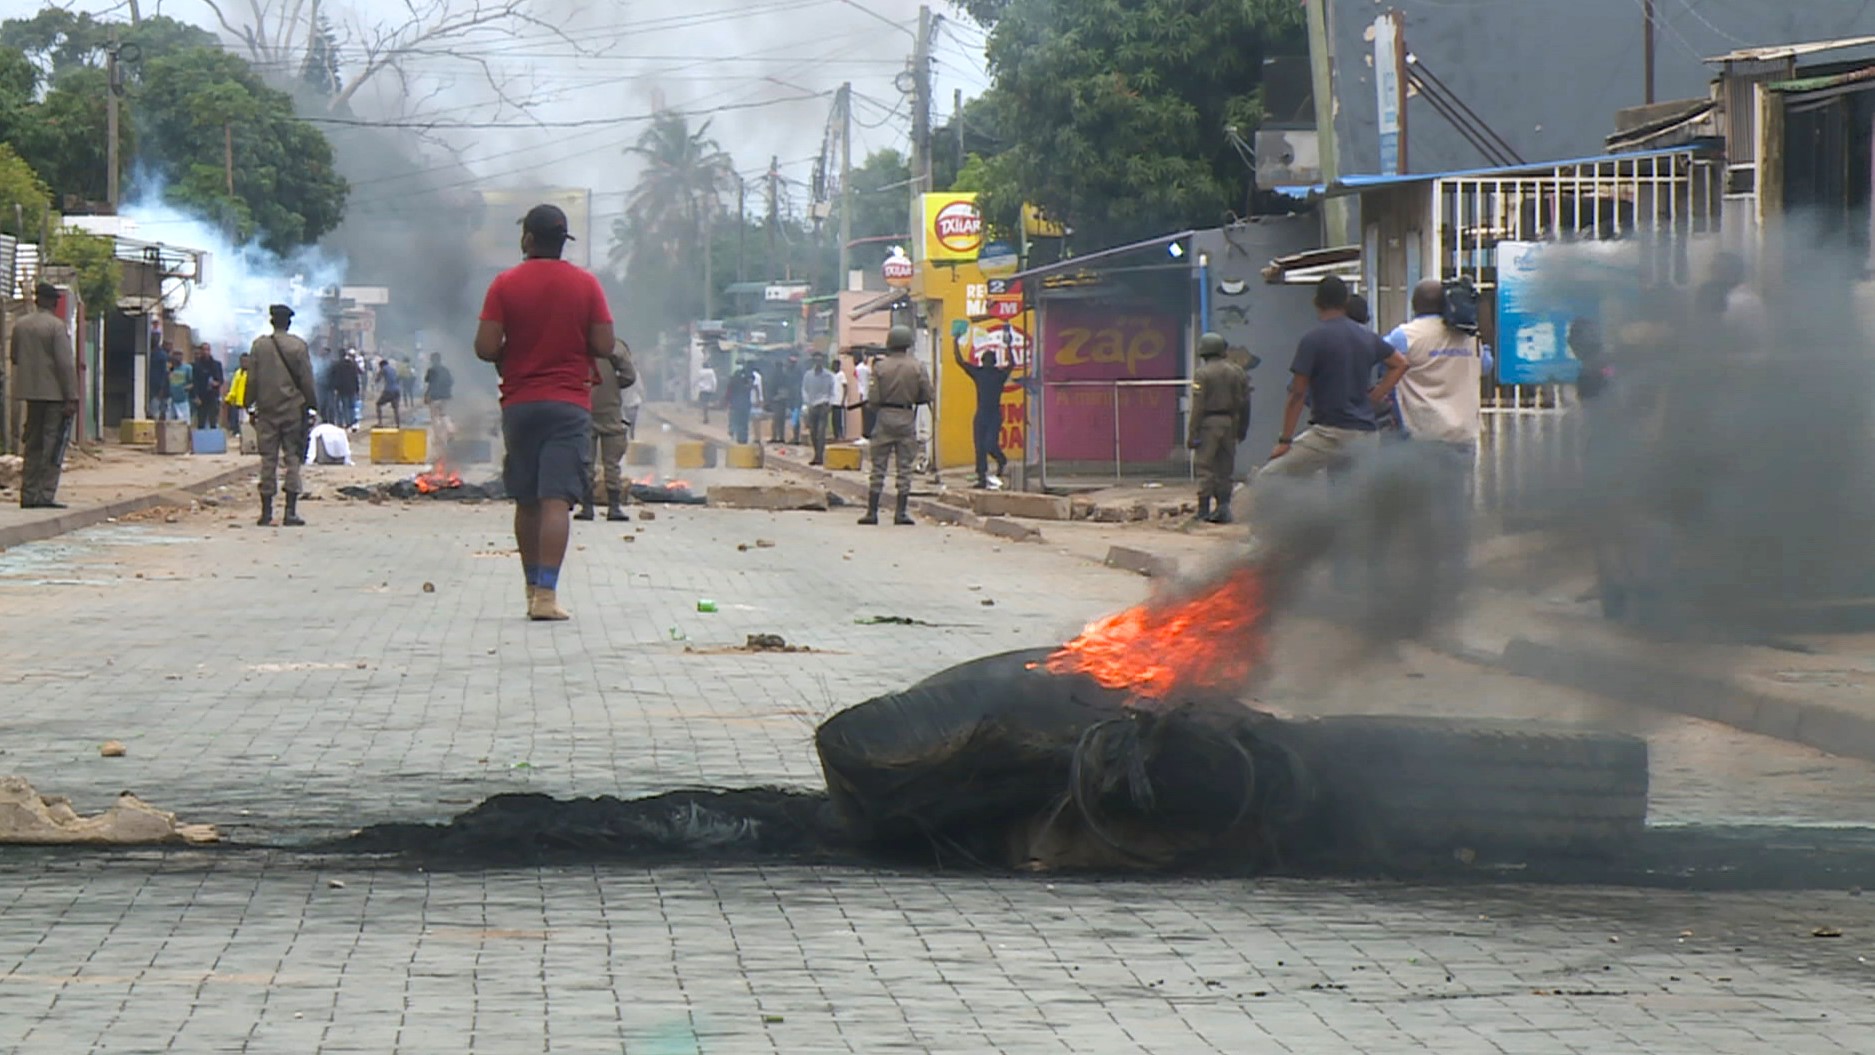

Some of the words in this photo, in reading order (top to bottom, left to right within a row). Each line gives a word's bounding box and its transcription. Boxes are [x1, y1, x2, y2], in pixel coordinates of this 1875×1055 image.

[966, 284, 988, 298] RE
[989, 280, 1005, 293] 2
[999, 302, 1018, 315] M
[1054, 327, 1165, 377] zap
